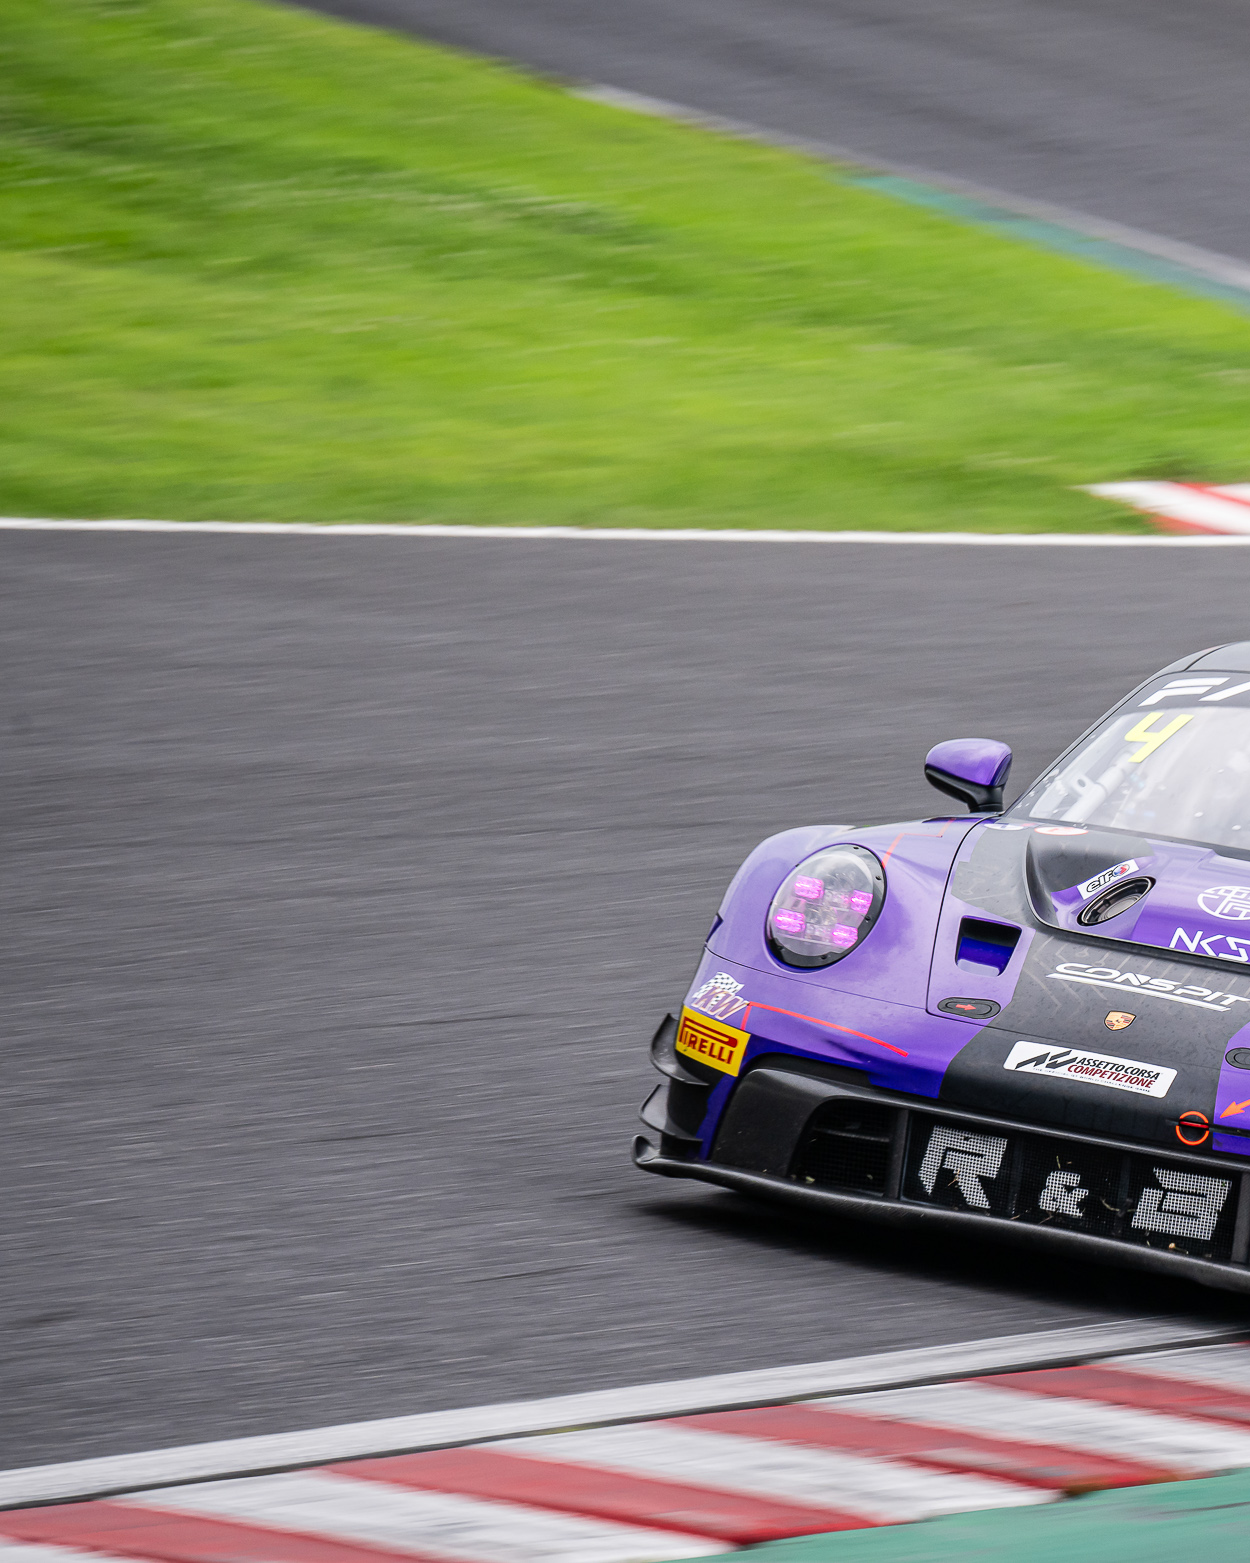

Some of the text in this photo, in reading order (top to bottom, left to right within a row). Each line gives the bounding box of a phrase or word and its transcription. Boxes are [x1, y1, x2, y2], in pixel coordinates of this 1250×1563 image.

[1124, 712, 1194, 764] 4
[1086, 869, 1115, 893] elf
[690, 984, 750, 1021] KW
[678, 1016, 738, 1065] PIRELLI
[1067, 1064, 1156, 1088] COMPETIZIONE
[1076, 1056, 1126, 1073] ASSETTO
[1124, 1066, 1161, 1081] CORSA
[918, 1125, 1009, 1209] R
[1038, 1170, 1089, 1217] &
